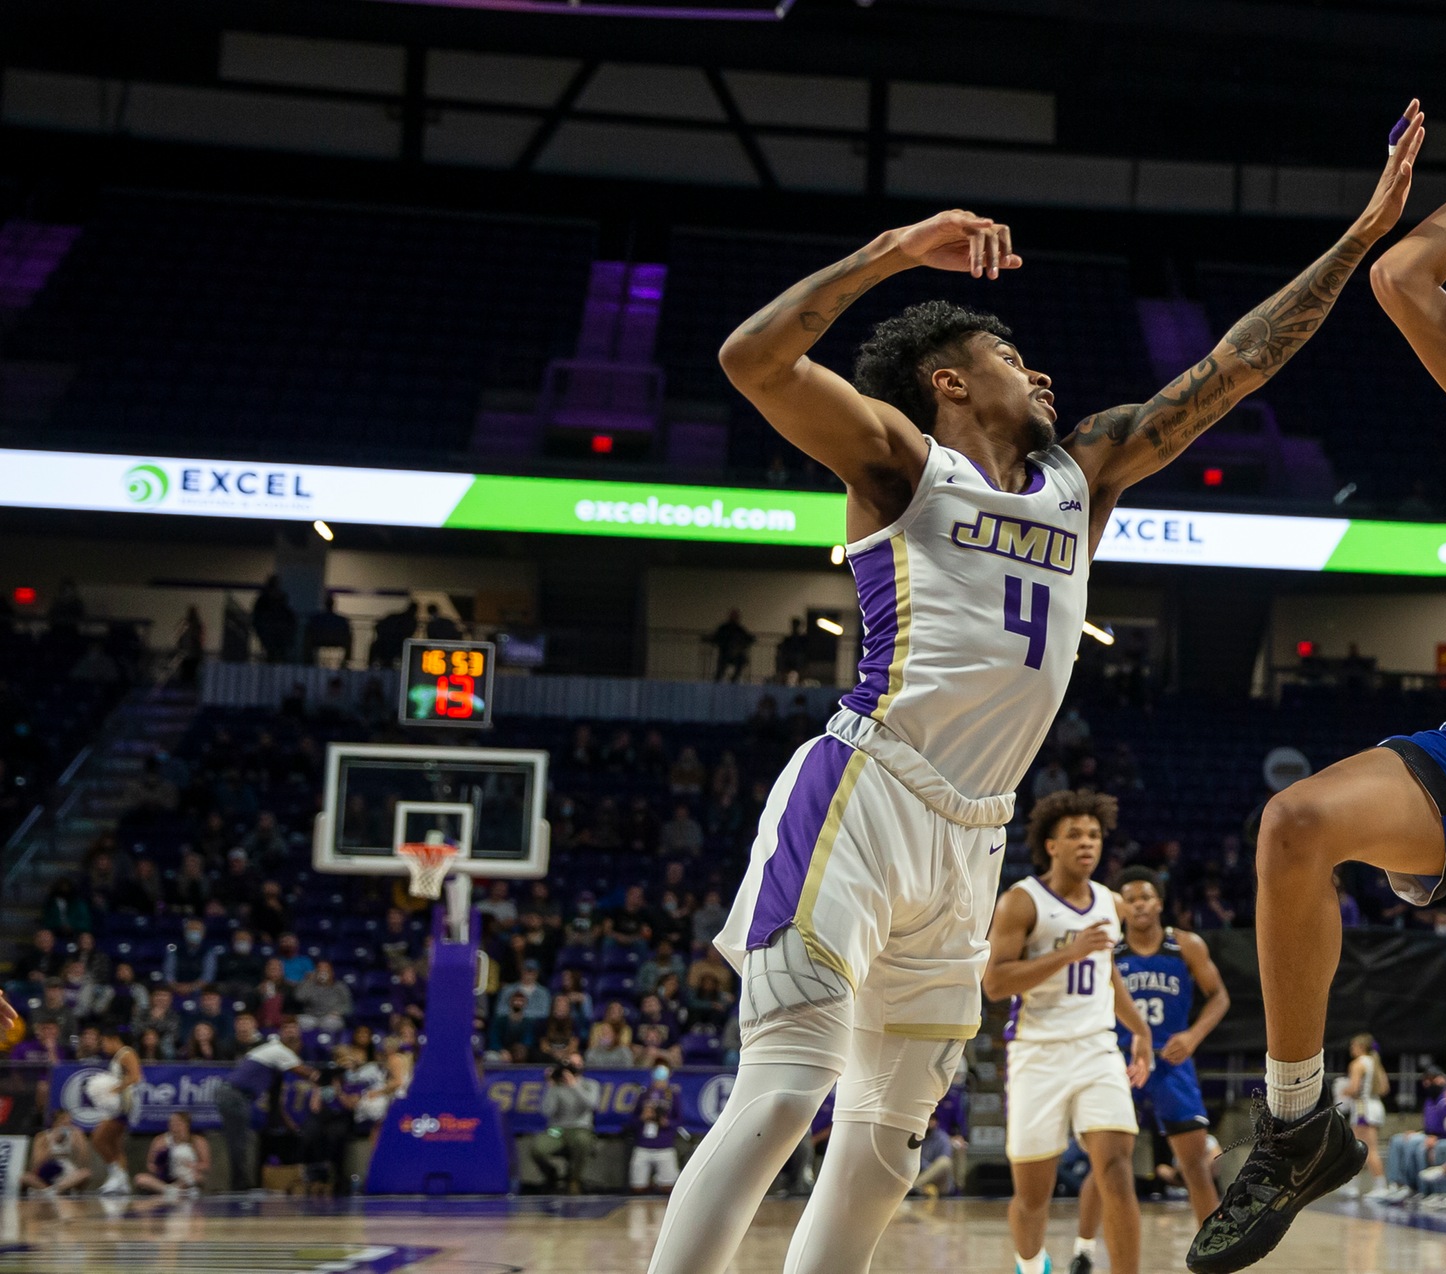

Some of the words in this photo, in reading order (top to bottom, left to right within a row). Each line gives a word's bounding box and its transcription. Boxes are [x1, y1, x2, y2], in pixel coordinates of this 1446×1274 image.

[181, 469, 312, 498] EXCEL
[575, 495, 796, 532] excelcool.com
[1059, 500, 1082, 512] CAA
[951, 510, 1078, 577] JMU
[1104, 517, 1203, 543] XCEL
[1003, 574, 1050, 671] 4
[435, 674, 475, 718] 13
[1066, 959, 1096, 996] 10
